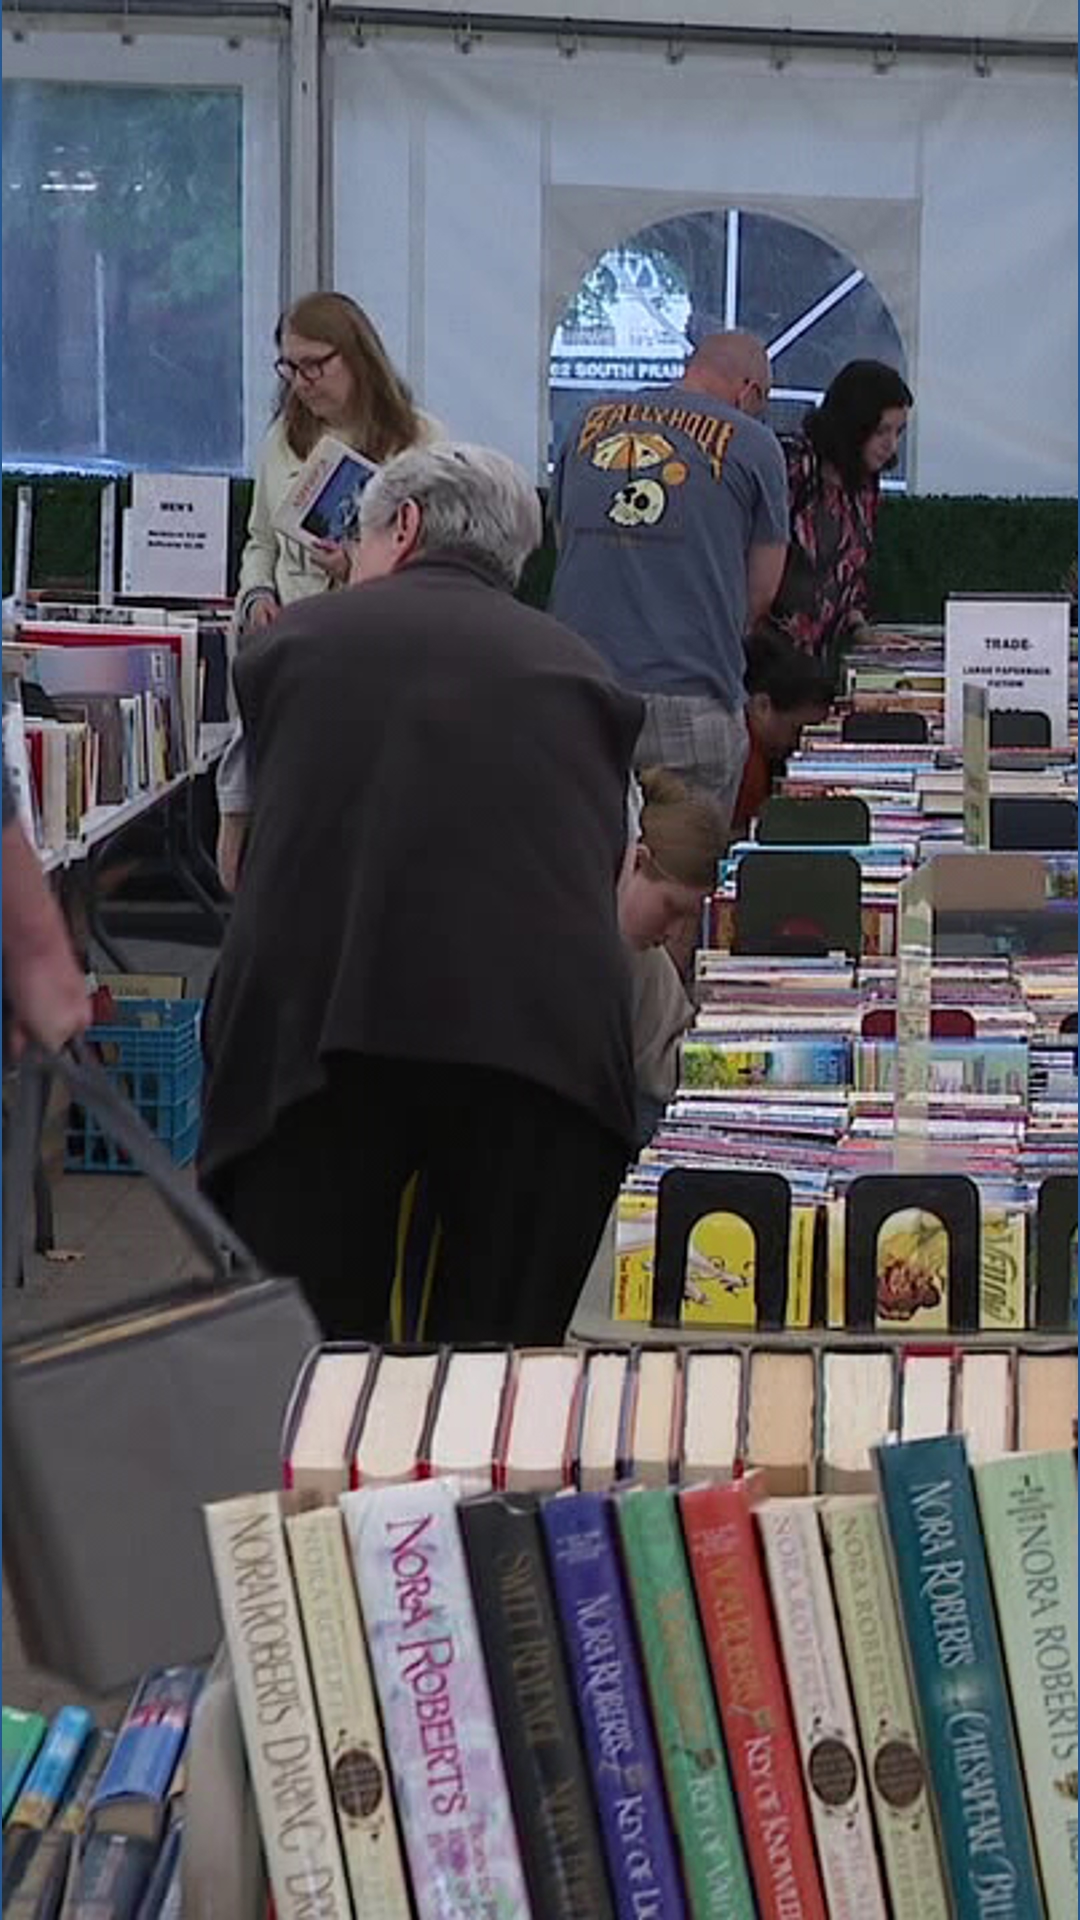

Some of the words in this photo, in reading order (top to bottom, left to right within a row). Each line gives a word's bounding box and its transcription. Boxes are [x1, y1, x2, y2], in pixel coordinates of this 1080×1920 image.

[574, 363, 634, 378] SOUTH
[229, 1513, 277, 1598] NORA
[773, 1516, 802, 1588] NORA
[911, 1480, 956, 1558] NORA
[386, 1515, 434, 1628] NORA
[840, 1516, 870, 1590] NORA
[855, 1600, 892, 1718] ROBERTS
[919, 1559, 976, 1669] ROBERTS
[1017, 1524, 1060, 1618] NORA
[240, 1597, 299, 1727] ROBERTS
[577, 1594, 617, 1664] NORA
[396, 1636, 468, 1817] ROBERTS
[582, 1661, 634, 1754] ROBERTS
[1033, 1624, 1079, 1762] ROBERTS
[260, 1733, 327, 1853] DARING
[744, 1735, 772, 1780] KEY
[756, 1783, 782, 1814] OF
[946, 1710, 1006, 1854] CHESAPEAKE
[615, 1796, 645, 1842] KEY
[626, 1851, 653, 1882] OF
